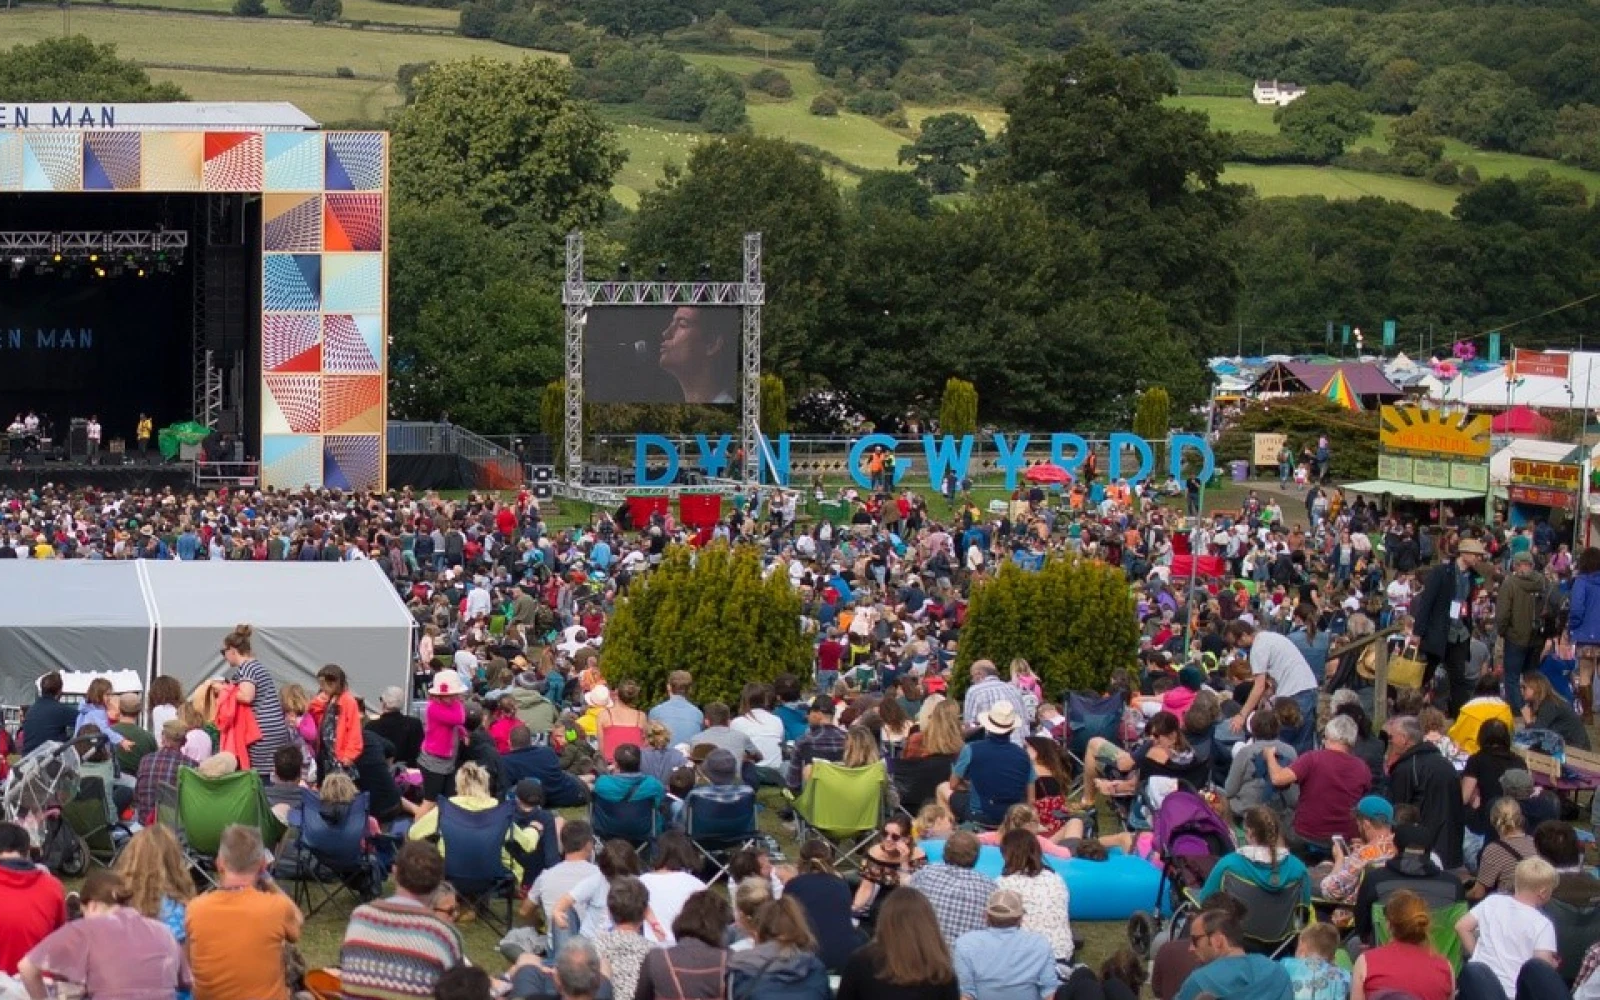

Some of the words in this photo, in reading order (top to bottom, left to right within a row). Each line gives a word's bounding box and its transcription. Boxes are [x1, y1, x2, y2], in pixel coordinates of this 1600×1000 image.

[52, 106, 115, 129] MAN
[37, 328, 93, 349] MAN
[635, 433, 791, 488] DYN
